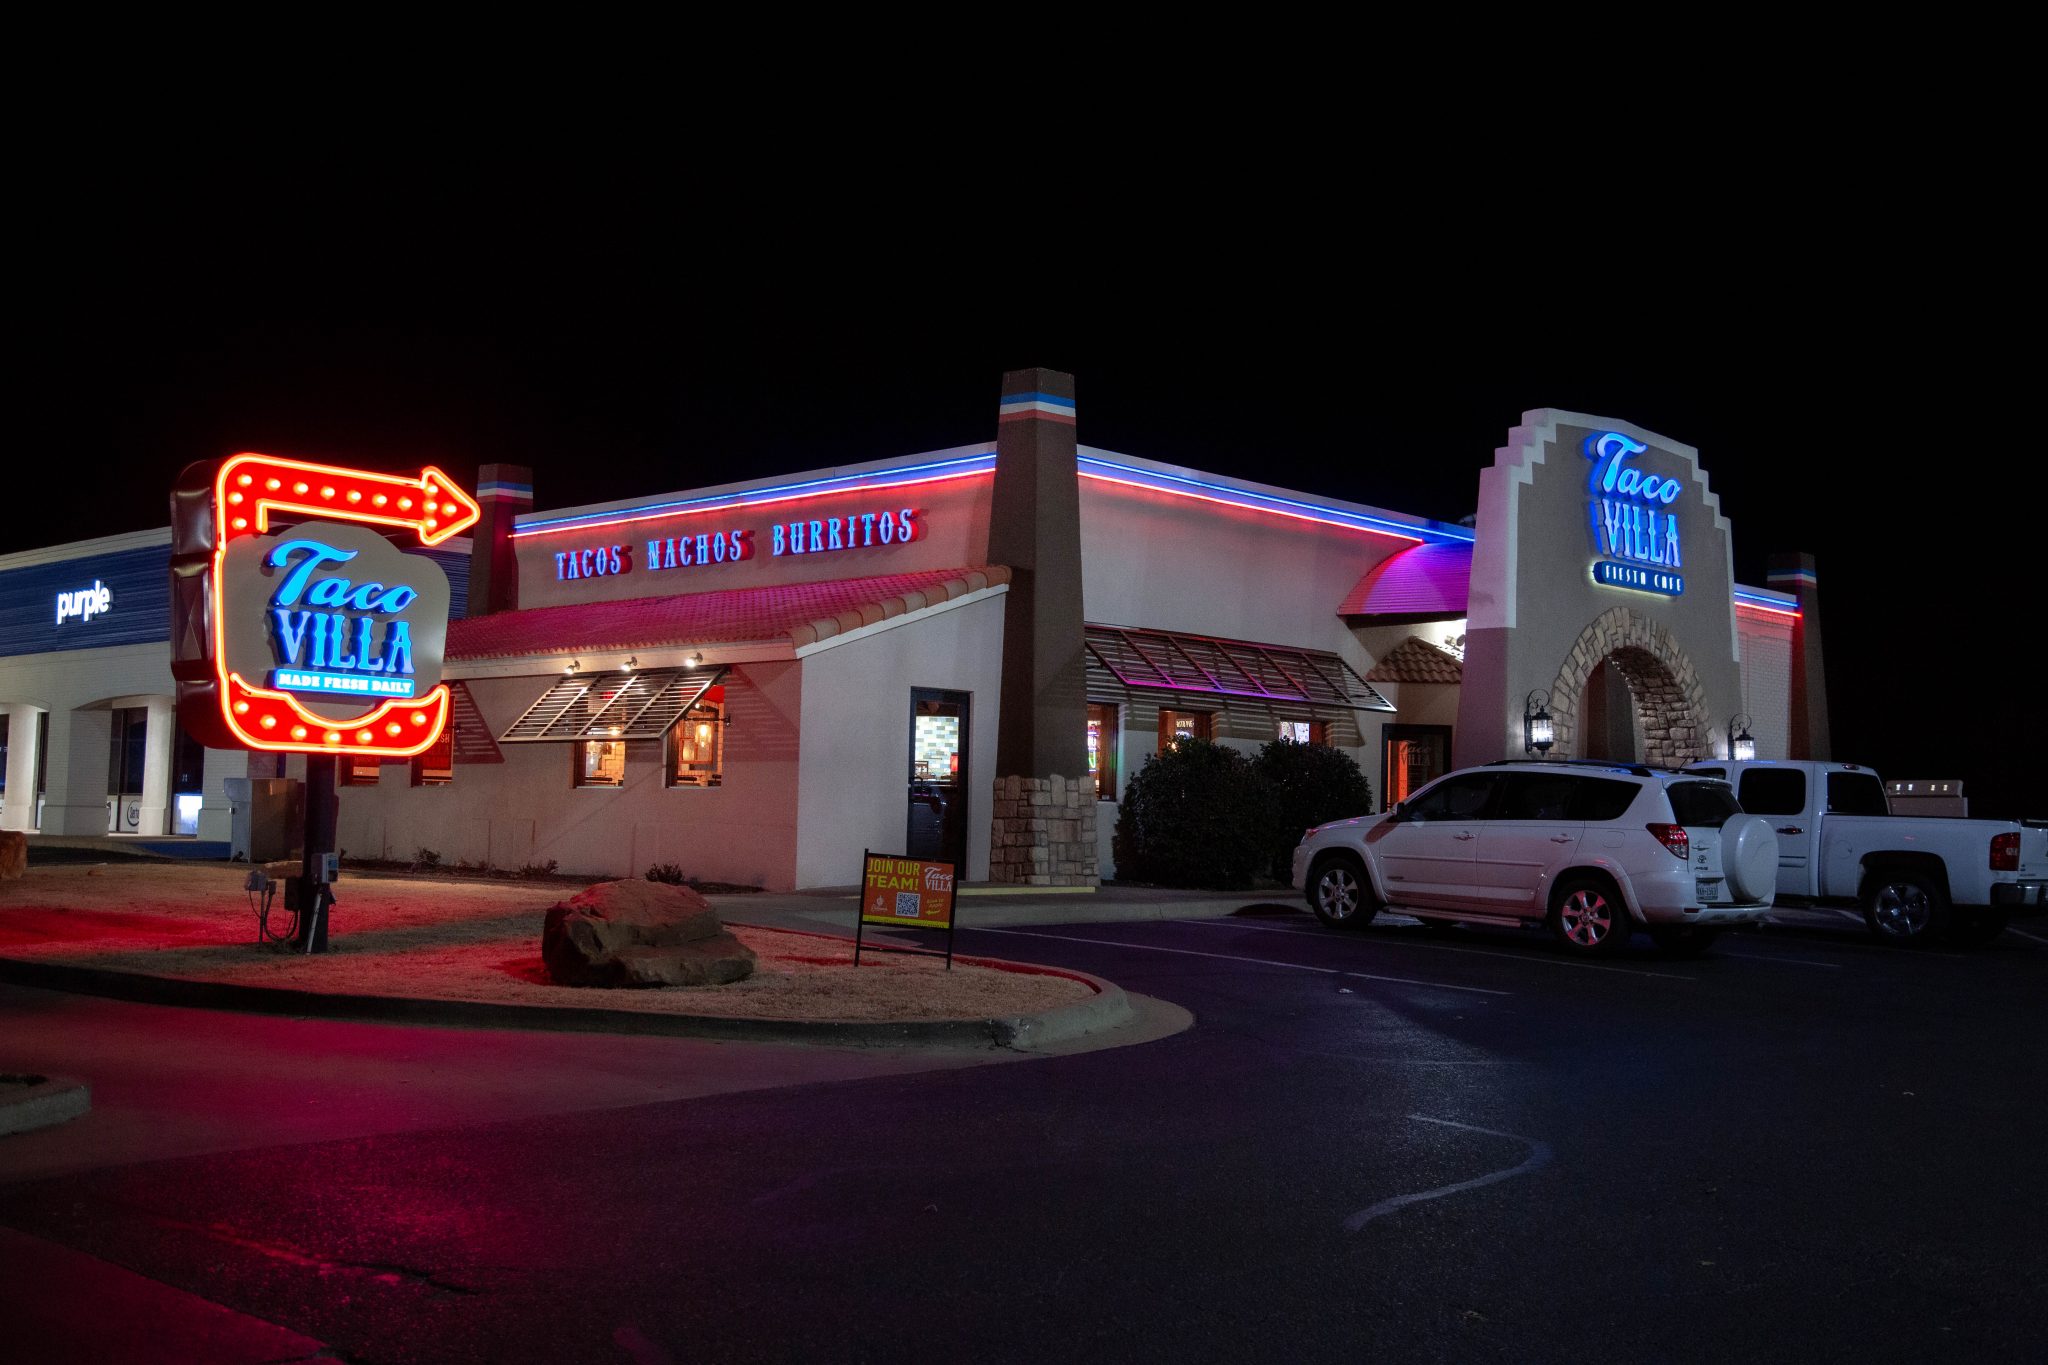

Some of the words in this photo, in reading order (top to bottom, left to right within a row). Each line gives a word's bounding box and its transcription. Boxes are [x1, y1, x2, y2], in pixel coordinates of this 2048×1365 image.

[1596, 432, 1682, 504] Taco
[556, 546, 622, 581] TACOS
[647, 530, 743, 570] NACHOS
[773, 509, 913, 557] BURRITOS
[1603, 499, 1680, 568] VILLA
[269, 539, 418, 614] Taco
[1605, 565, 1646, 586] FIESTA
[1654, 574, 1682, 592] CAFE
[56, 580, 111, 625] purple
[276, 608, 415, 675] VILLA
[278, 673, 319, 688] MADE
[323, 675, 369, 692] FRESH
[371, 678, 413, 695] DAILY
[867, 859, 893, 874] JOIN
[897, 861, 920, 876] OUR
[867, 874, 919, 891] TEAM!
[924, 867, 953, 881] Taco
[925, 879, 952, 892] VILLA
